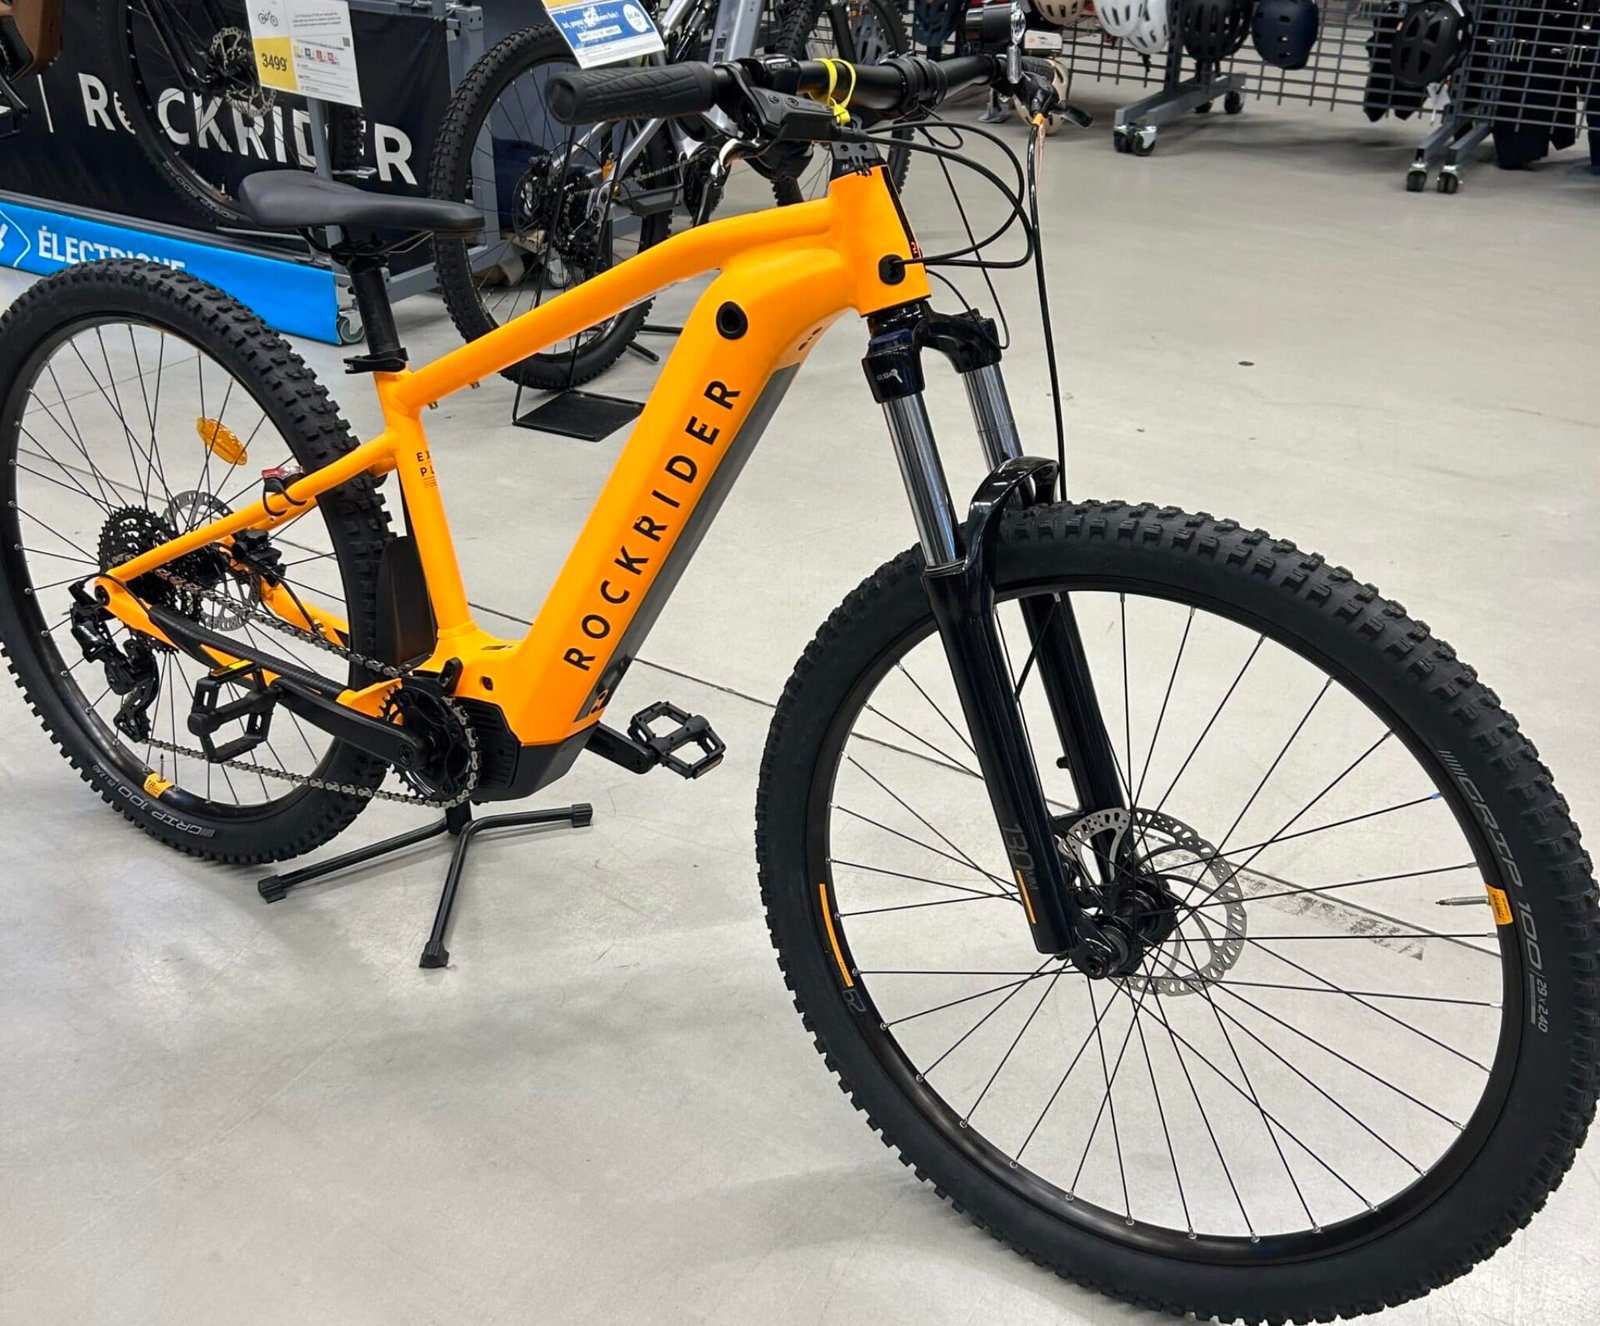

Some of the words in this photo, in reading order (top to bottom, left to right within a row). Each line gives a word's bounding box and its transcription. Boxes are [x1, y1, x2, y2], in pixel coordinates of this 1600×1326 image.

[78, 72, 418, 186] RCKRIDR
[564, 380, 740, 671] ROCKRIDER
[118, 785, 148, 810] 100
[151, 810, 203, 836] GRIP
[1459, 775, 1523, 887] GRIP
[1519, 901, 1542, 971] 100
